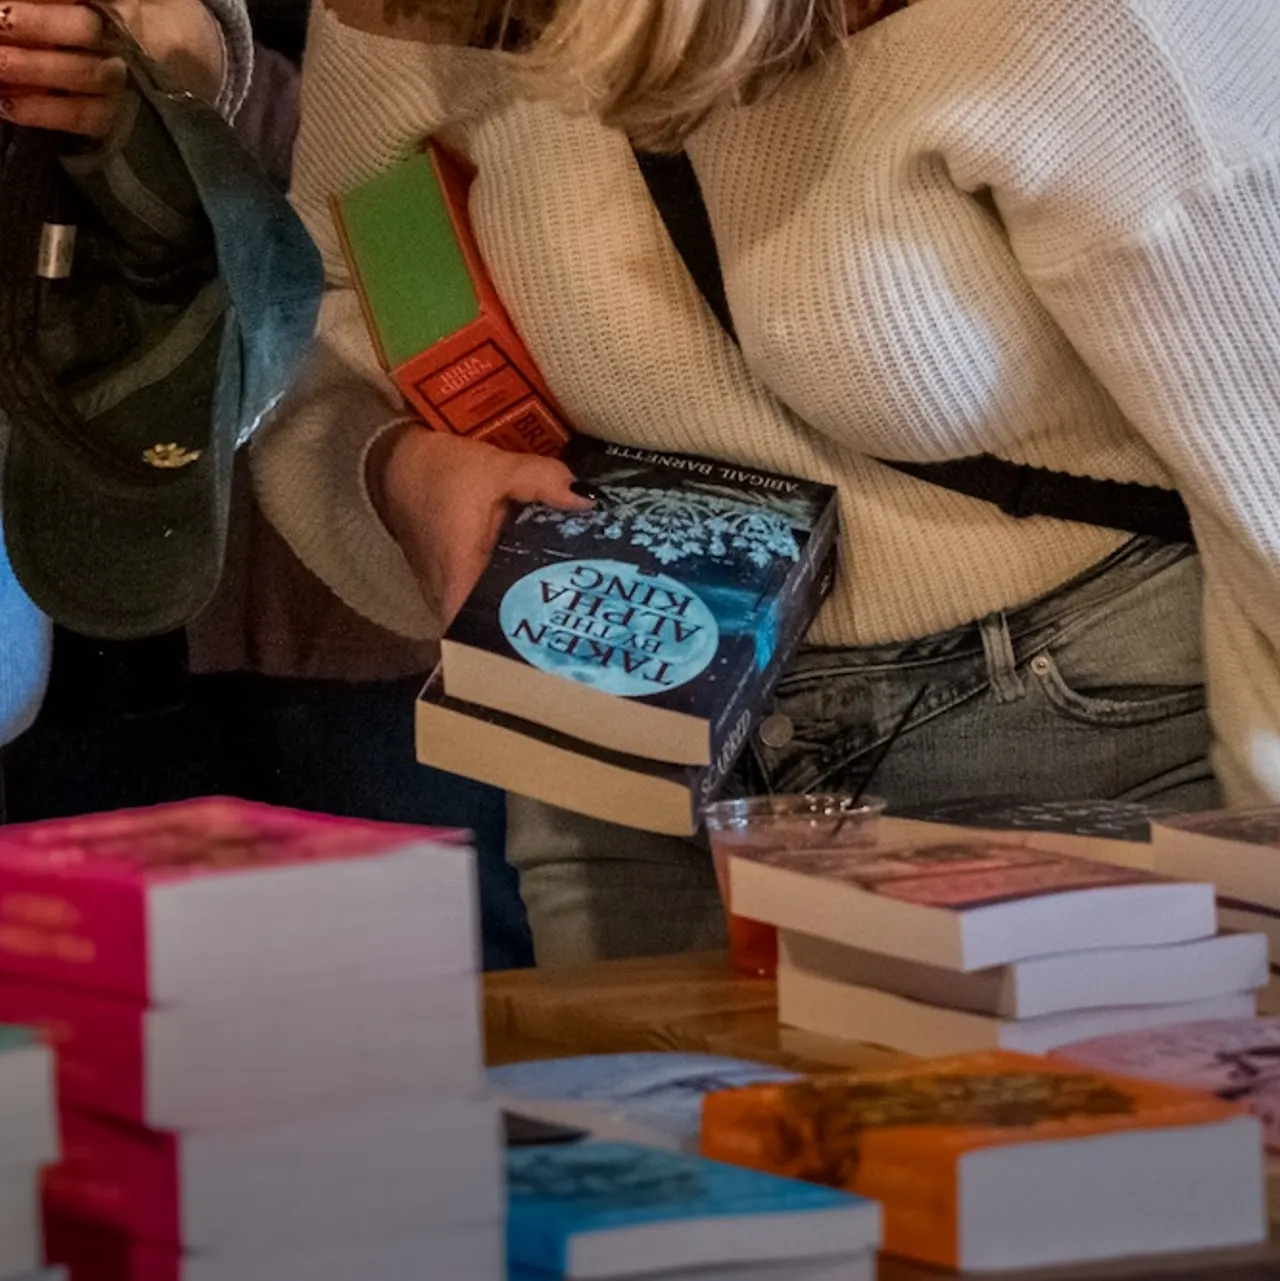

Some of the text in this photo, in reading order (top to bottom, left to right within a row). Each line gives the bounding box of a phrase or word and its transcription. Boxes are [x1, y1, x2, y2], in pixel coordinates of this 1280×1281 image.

[440, 356, 481, 384] JULIA
[440, 358, 494, 396] QUINN
[605, 443, 800, 493] ABIGAIL BARNETTE
[540, 580, 704, 643] ALPHA
[570, 565, 695, 618] KING
[511, 618, 674, 686] TAKEN
[549, 610, 663, 654] BY THE
